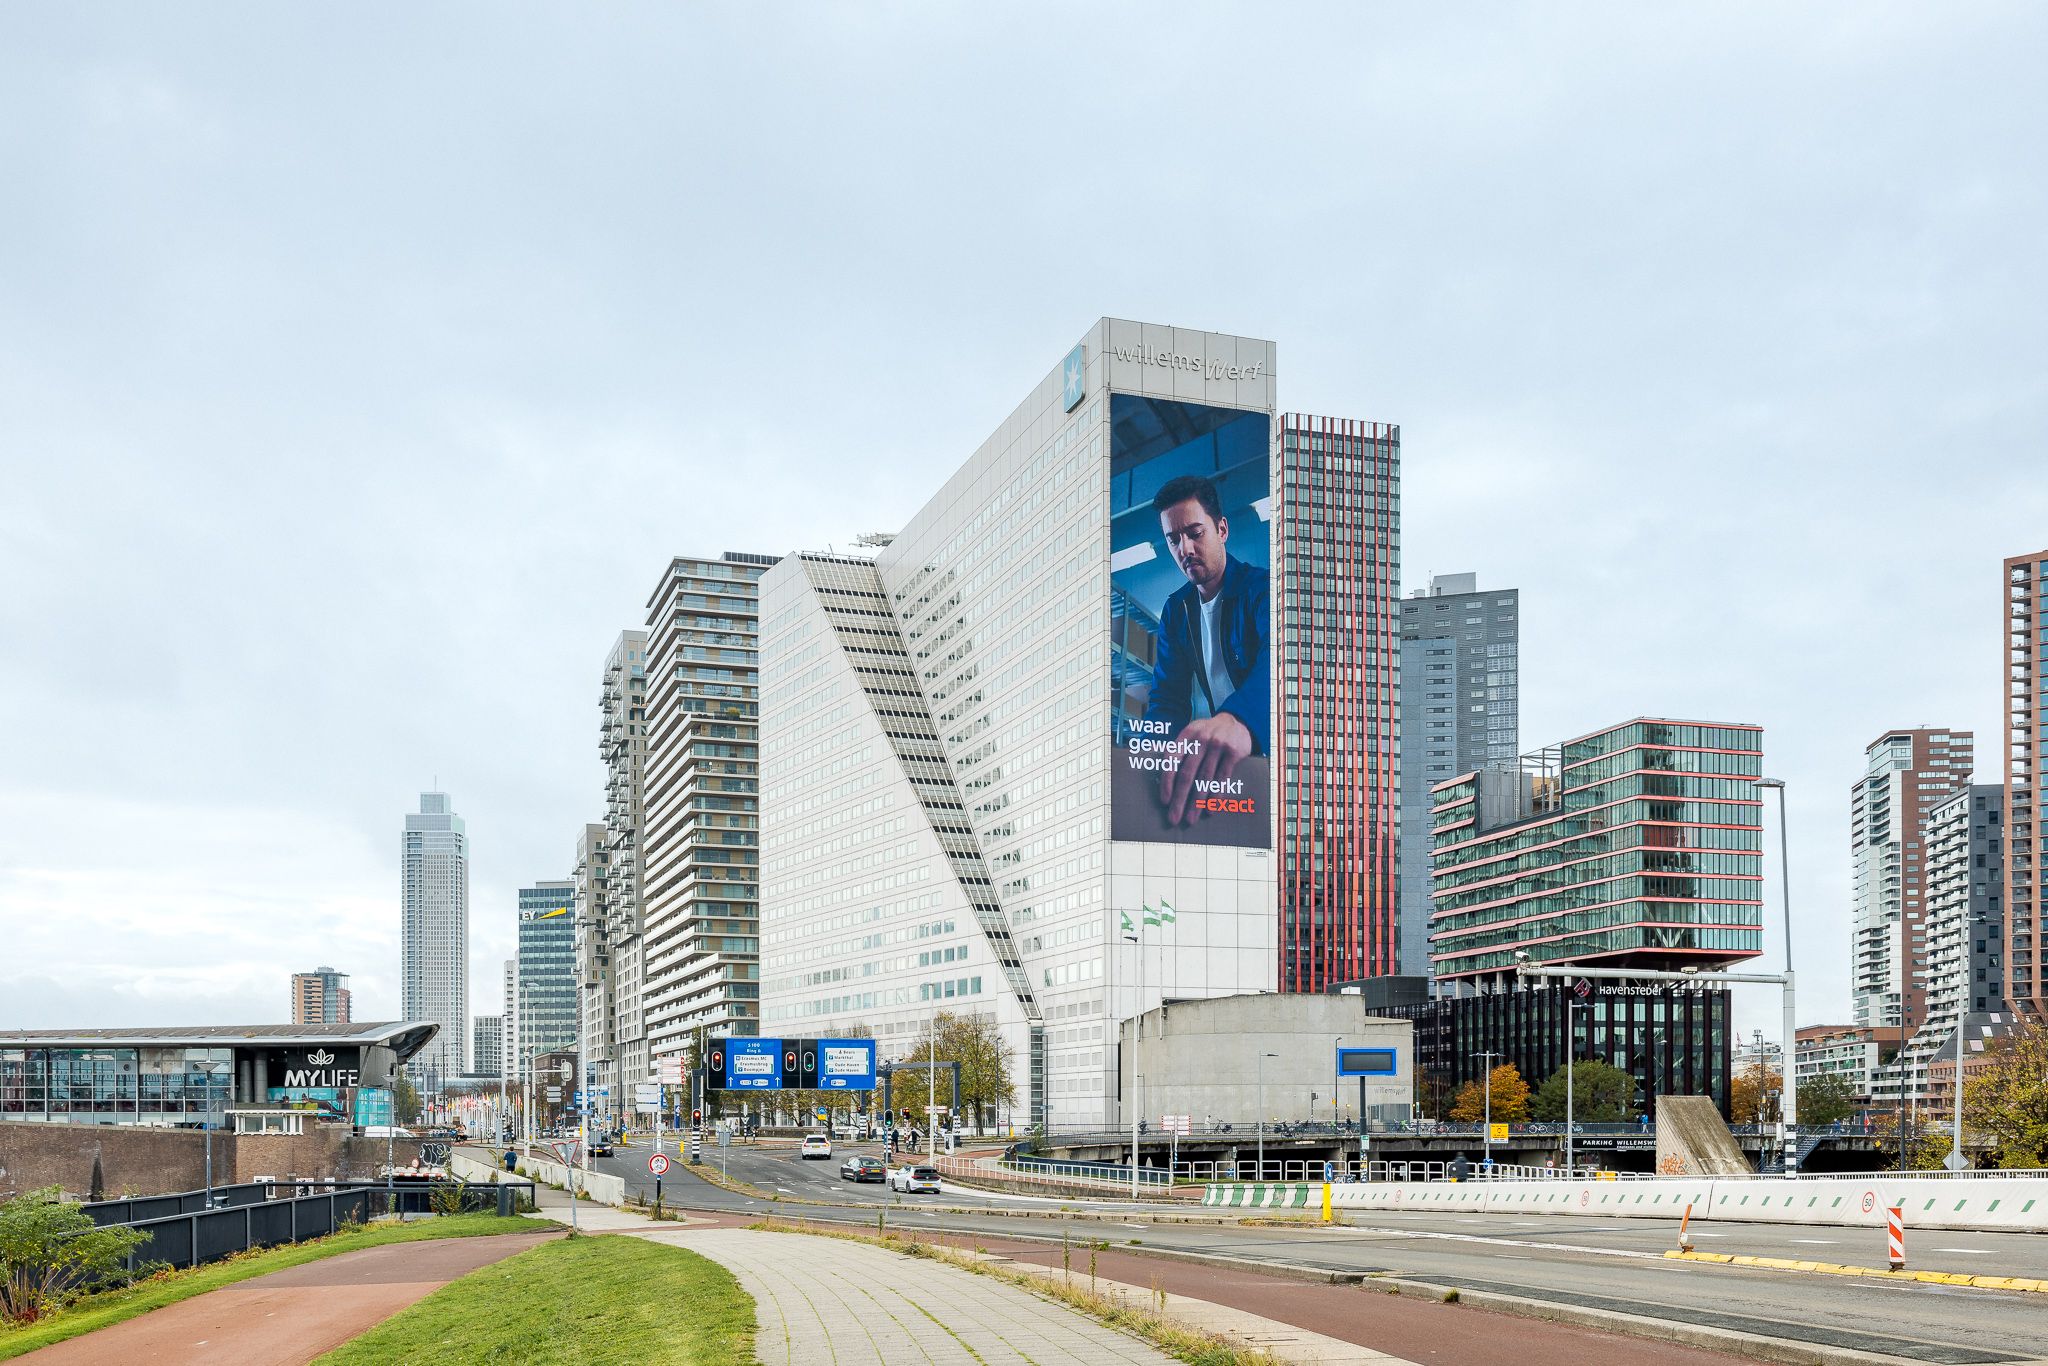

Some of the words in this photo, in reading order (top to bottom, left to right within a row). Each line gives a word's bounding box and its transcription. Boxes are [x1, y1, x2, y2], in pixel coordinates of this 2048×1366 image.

[1129, 719, 1171, 735] waar
[1129, 738, 1201, 756] gewerkt
[1129, 756, 1181, 772] wordt
[1195, 778, 1244, 794] werkt
[522, 910, 537, 920] EY
[1865, 1198, 1872, 1207] 50
